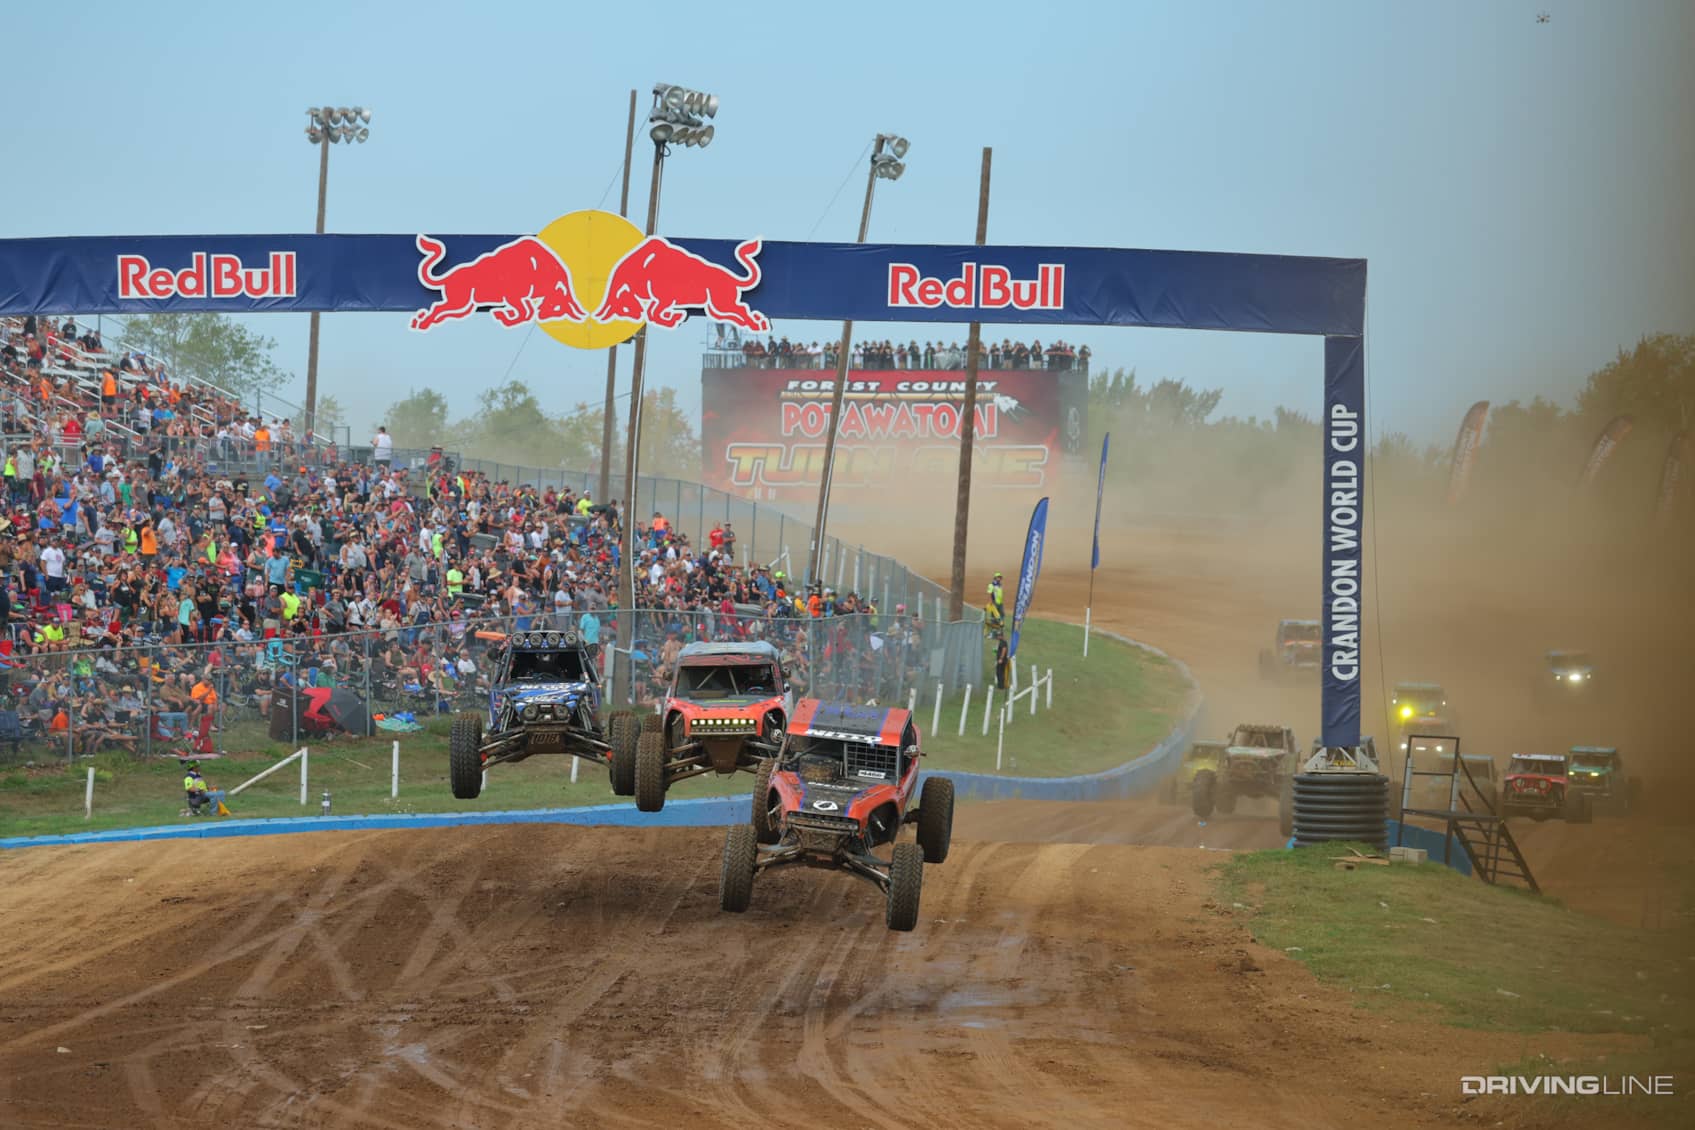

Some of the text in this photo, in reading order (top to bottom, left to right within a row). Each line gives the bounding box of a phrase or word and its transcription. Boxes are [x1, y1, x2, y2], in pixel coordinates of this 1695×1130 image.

[787, 380, 998, 392] FORST COUNY
[1331, 403, 1358, 681] CRANDON WORLD CUP
